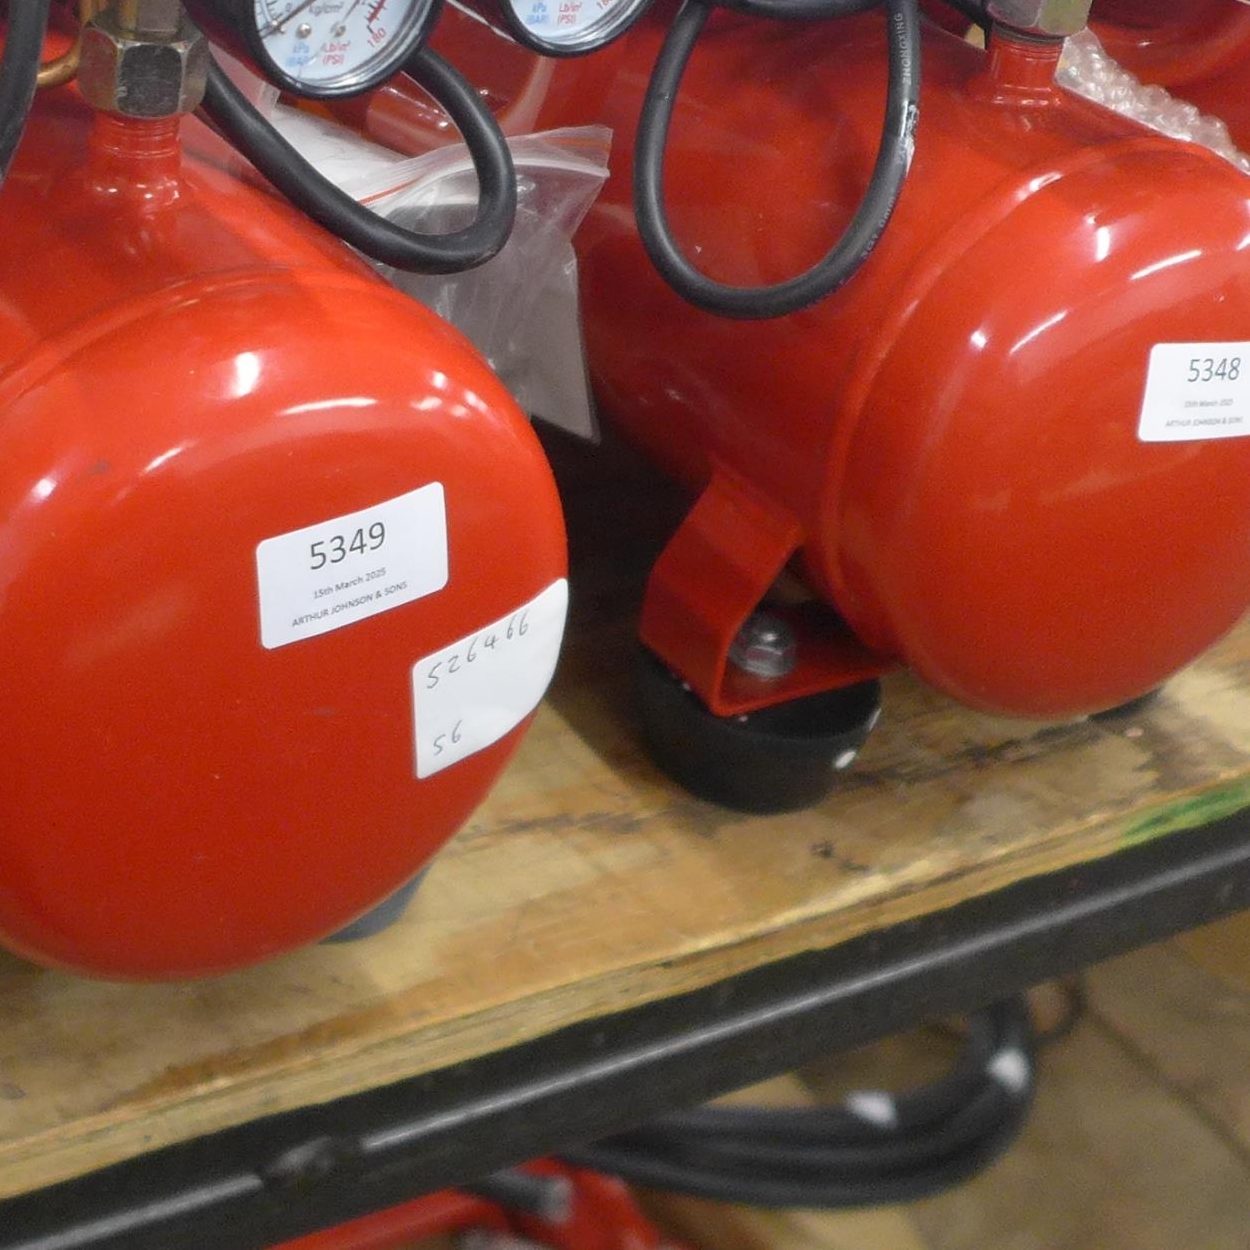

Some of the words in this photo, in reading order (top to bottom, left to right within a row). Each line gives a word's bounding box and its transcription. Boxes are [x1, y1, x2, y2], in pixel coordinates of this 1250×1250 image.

[1187, 356, 1242, 383] 5348
[310, 521, 386, 570] 5349
[313, 585, 334, 599] 15th
[334, 575, 364, 593] March
[365, 567, 387, 583] 2025
[292, 608, 330, 628] ARTHUR
[331, 593, 374, 616] JOHNSON
[375, 590, 383, 600] &
[384, 580, 408, 597] SONS
[432, 718, 464, 757] 56
